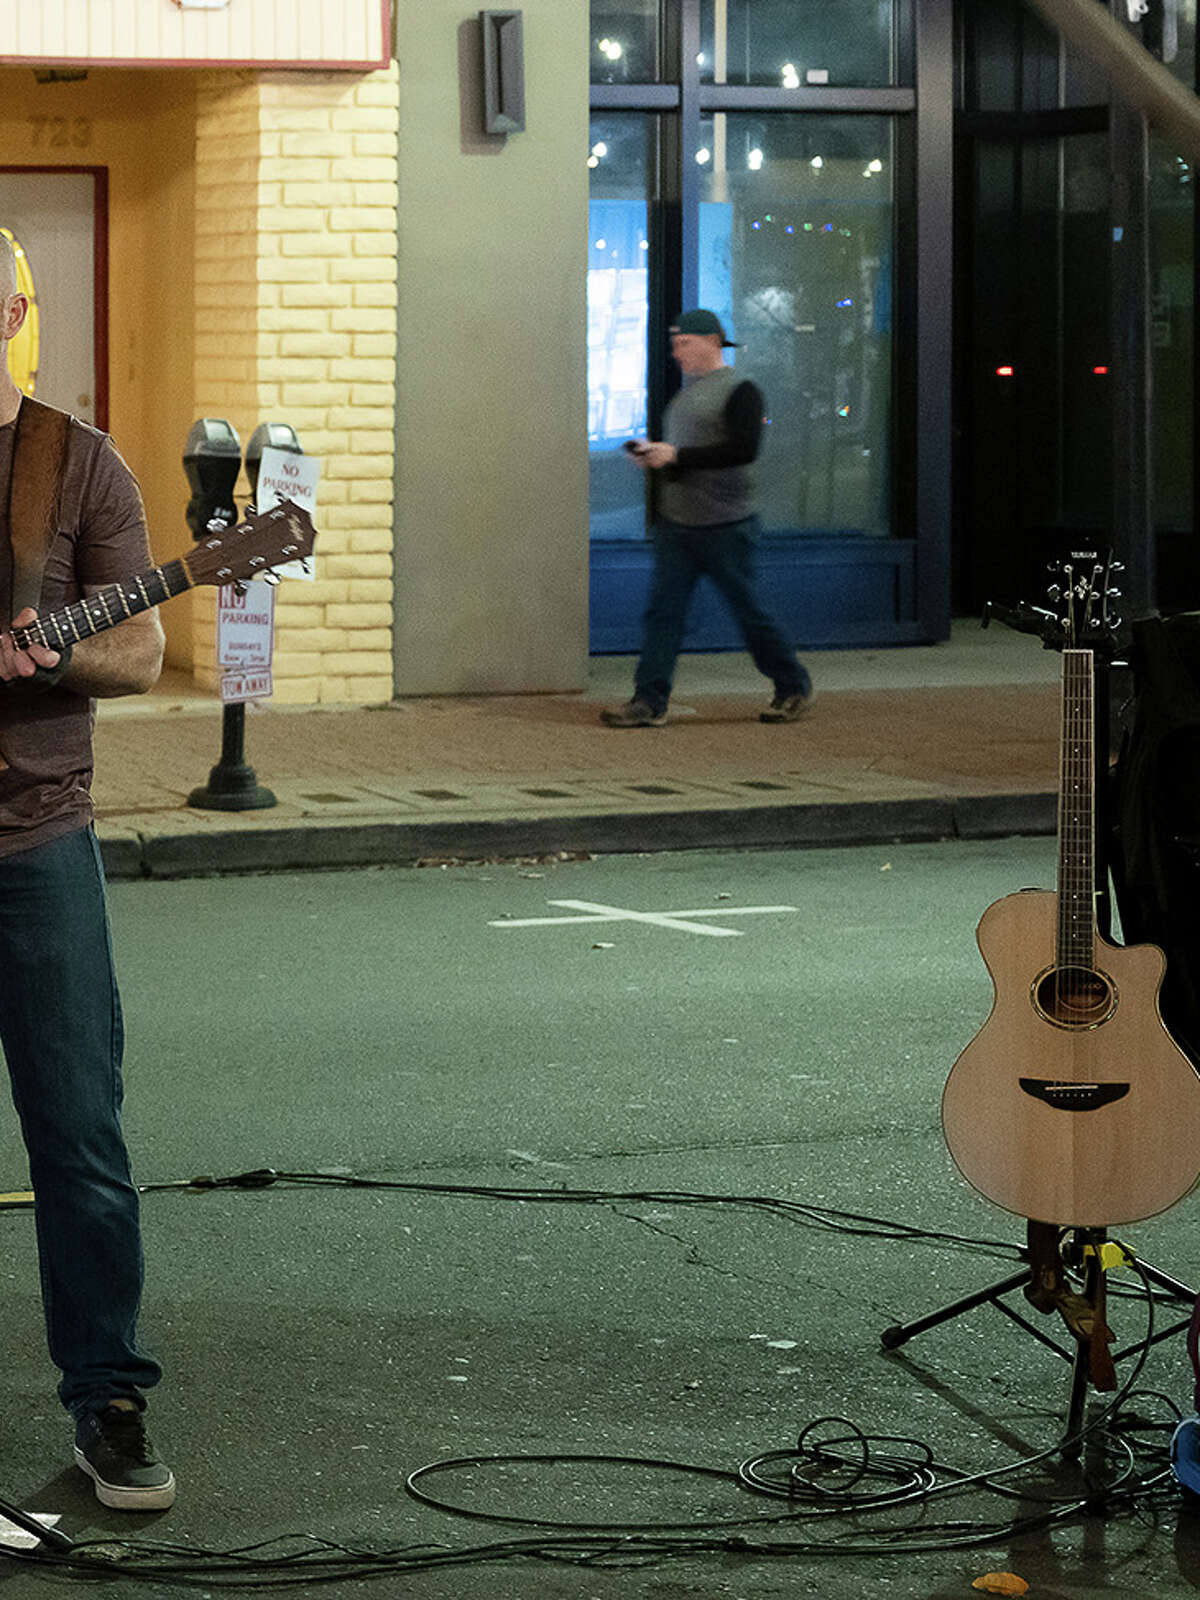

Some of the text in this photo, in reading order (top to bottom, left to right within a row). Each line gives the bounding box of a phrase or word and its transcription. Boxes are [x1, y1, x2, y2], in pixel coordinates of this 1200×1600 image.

[27, 115, 93, 148] 723
[281, 463, 300, 478] NO
[263, 476, 313, 498] PARKING
[221, 584, 245, 608] NO
[222, 612, 269, 625] PARKING
[224, 676, 268, 697] TOW AWAY
